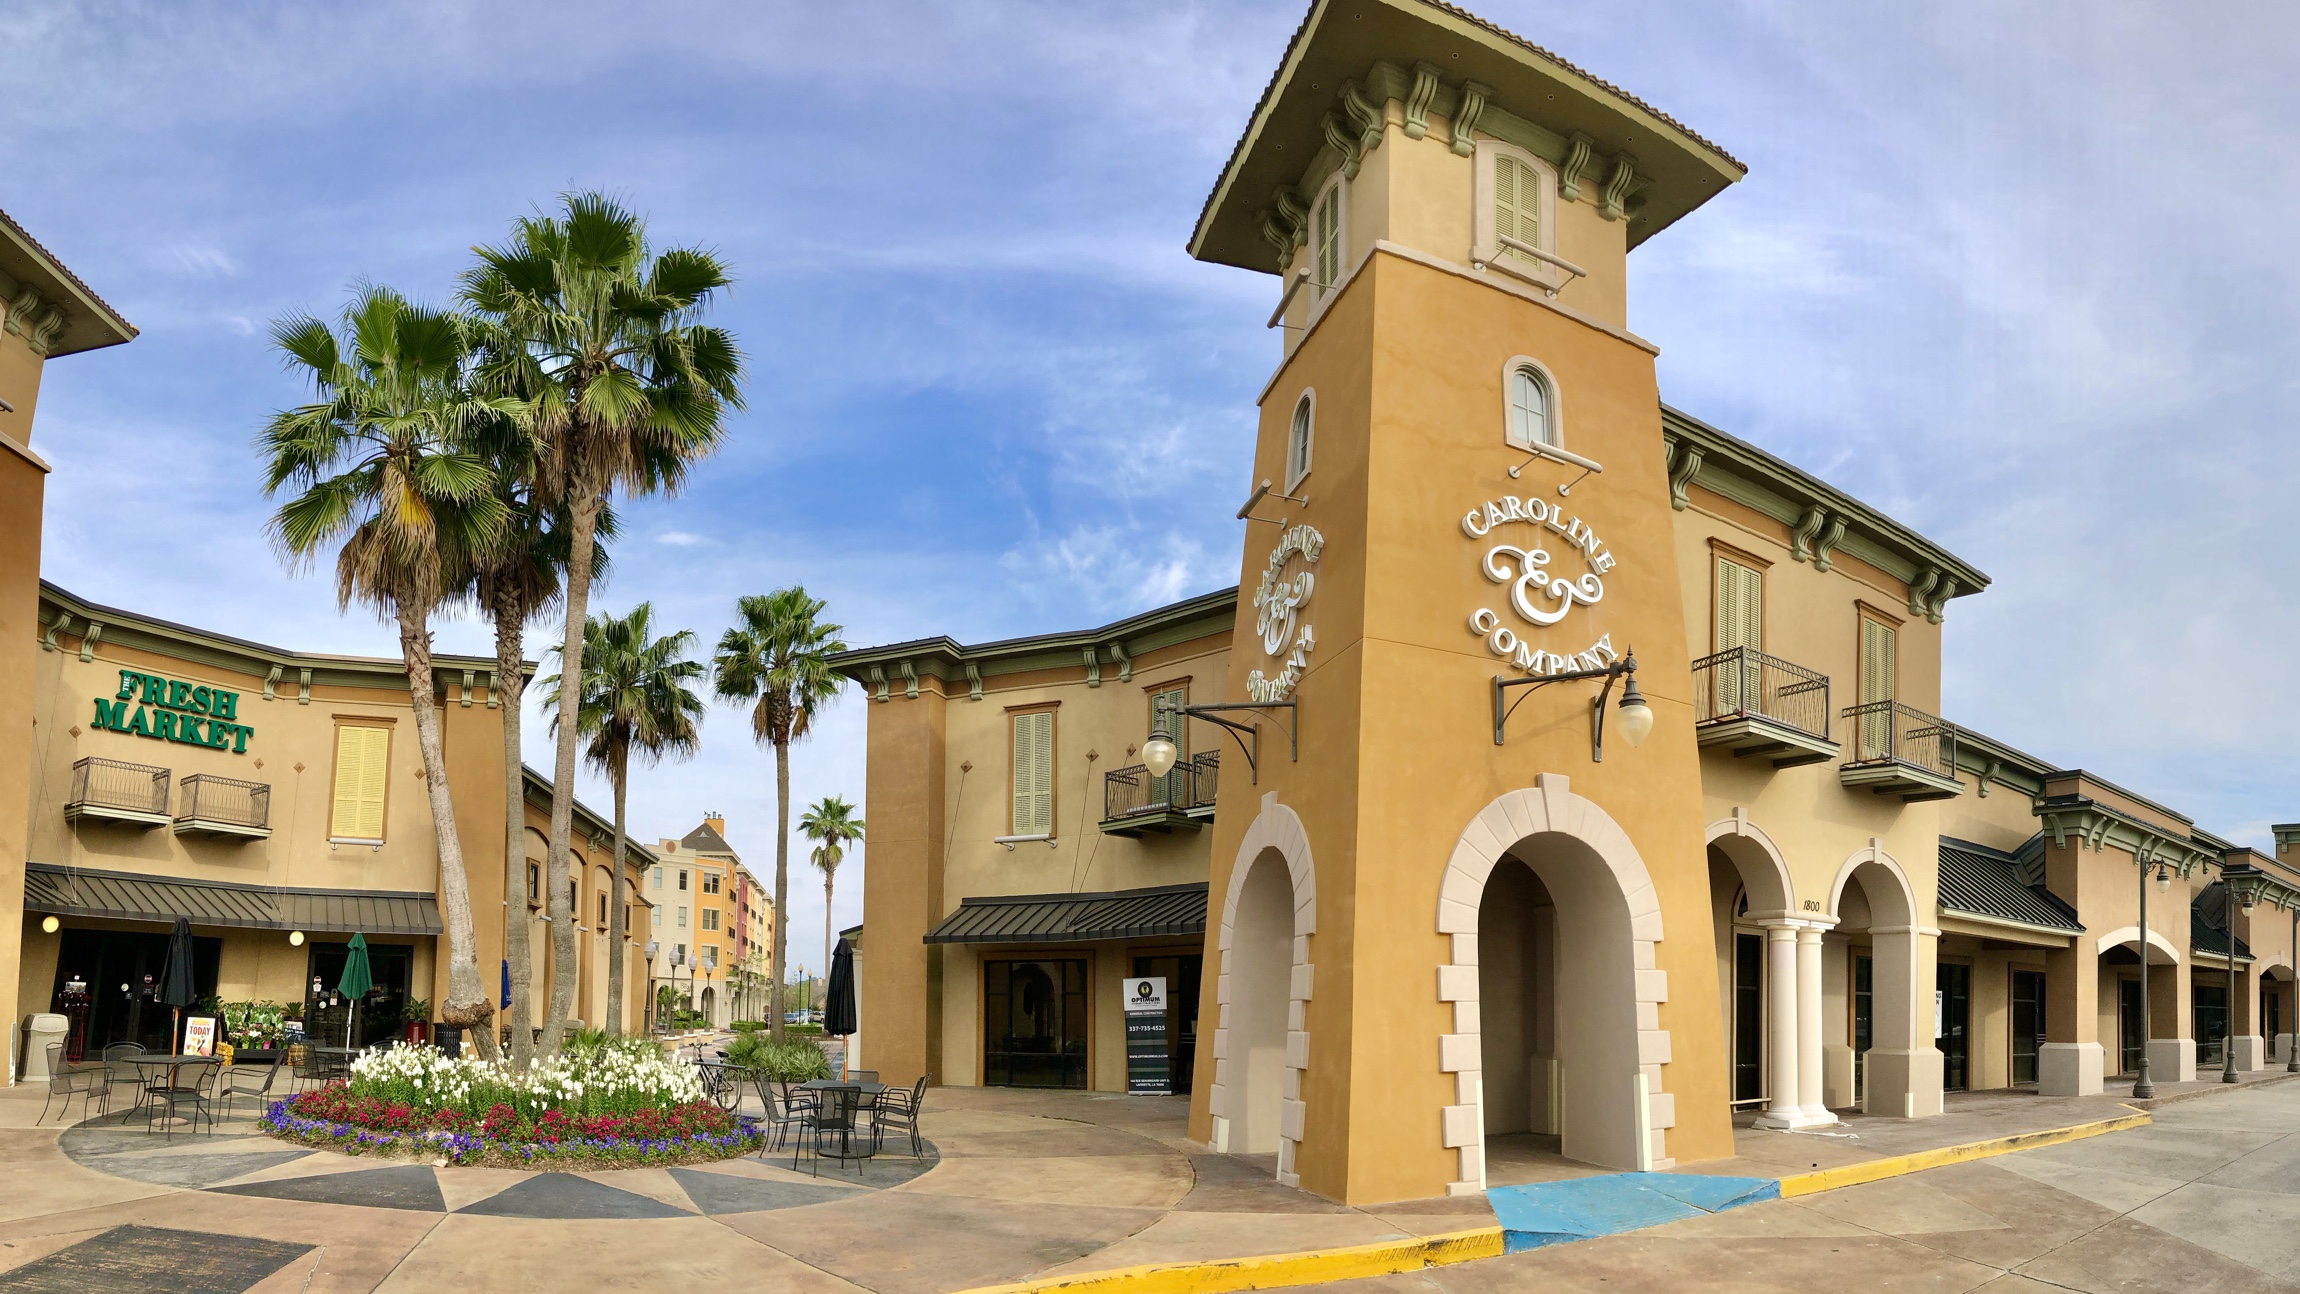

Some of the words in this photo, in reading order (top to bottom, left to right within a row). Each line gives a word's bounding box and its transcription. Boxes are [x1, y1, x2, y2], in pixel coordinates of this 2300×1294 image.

[1253, 524, 1325, 608] CAROLINE
[1461, 495, 1616, 576] CAROLINE
[1256, 571, 1315, 657] &
[1482, 545, 1604, 626] &
[1468, 608, 1619, 678] COMPANY
[115, 669, 240, 720] FRESH
[122, 676, 131, 692] THE
[90, 697, 254, 754] MARKET
[1803, 900, 1820, 912] 1800
[189, 1025, 211, 1036] TODAY
